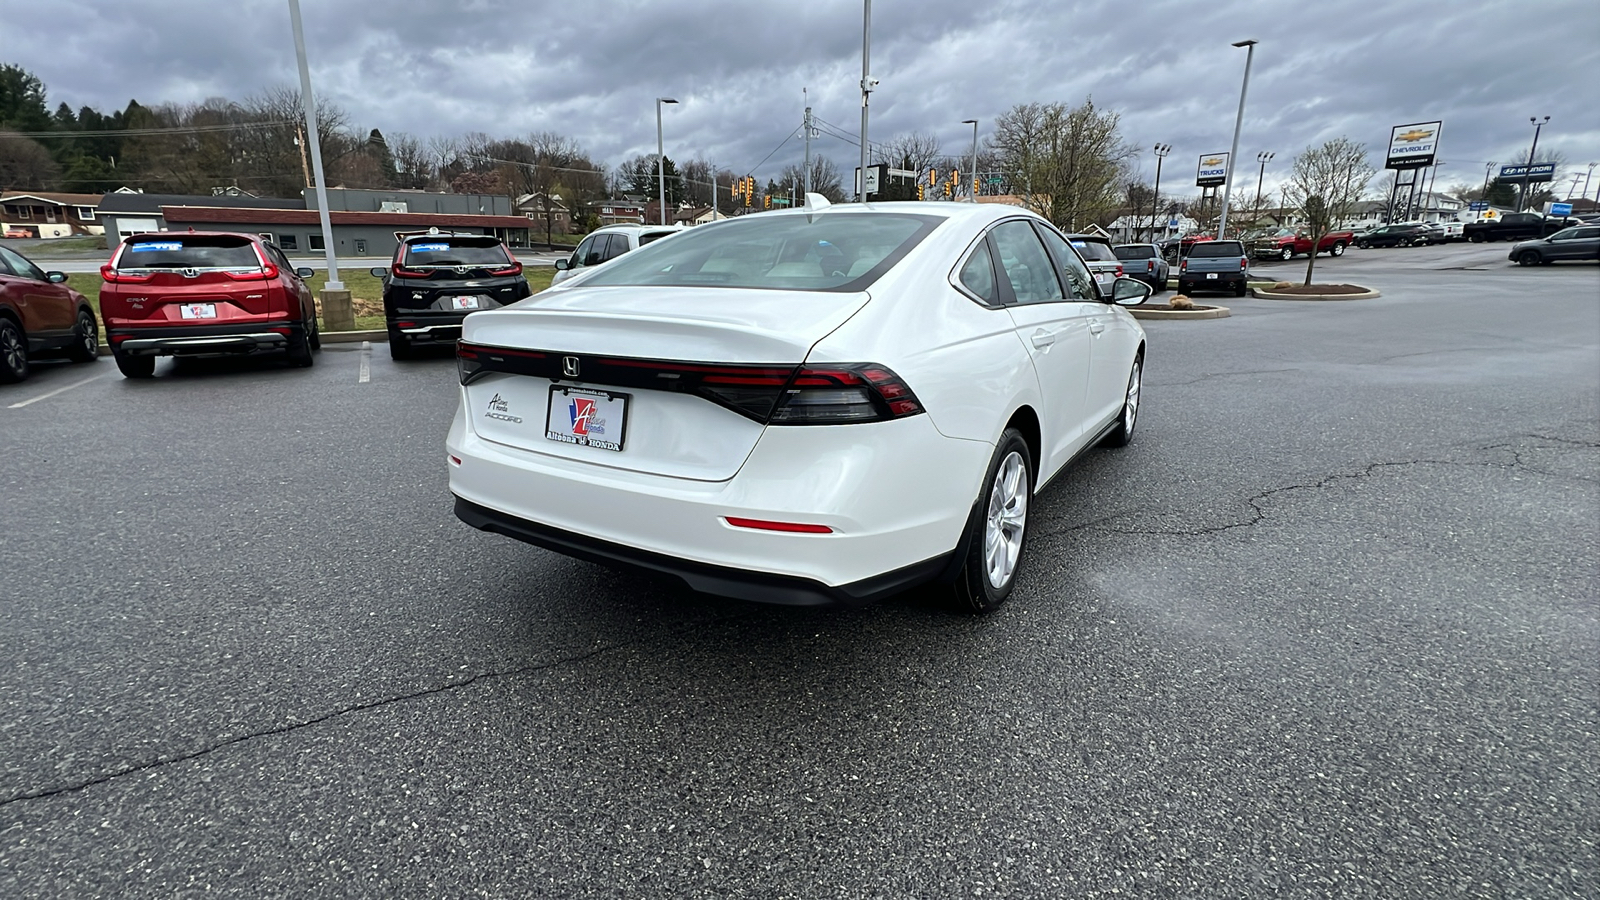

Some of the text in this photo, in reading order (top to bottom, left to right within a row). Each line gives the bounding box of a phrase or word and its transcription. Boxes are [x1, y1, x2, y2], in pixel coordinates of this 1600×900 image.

[1391, 144, 1432, 154] CHEVROLET
[485, 411, 522, 423] ACCORD
[546, 431, 620, 451] Altoona HONDA
